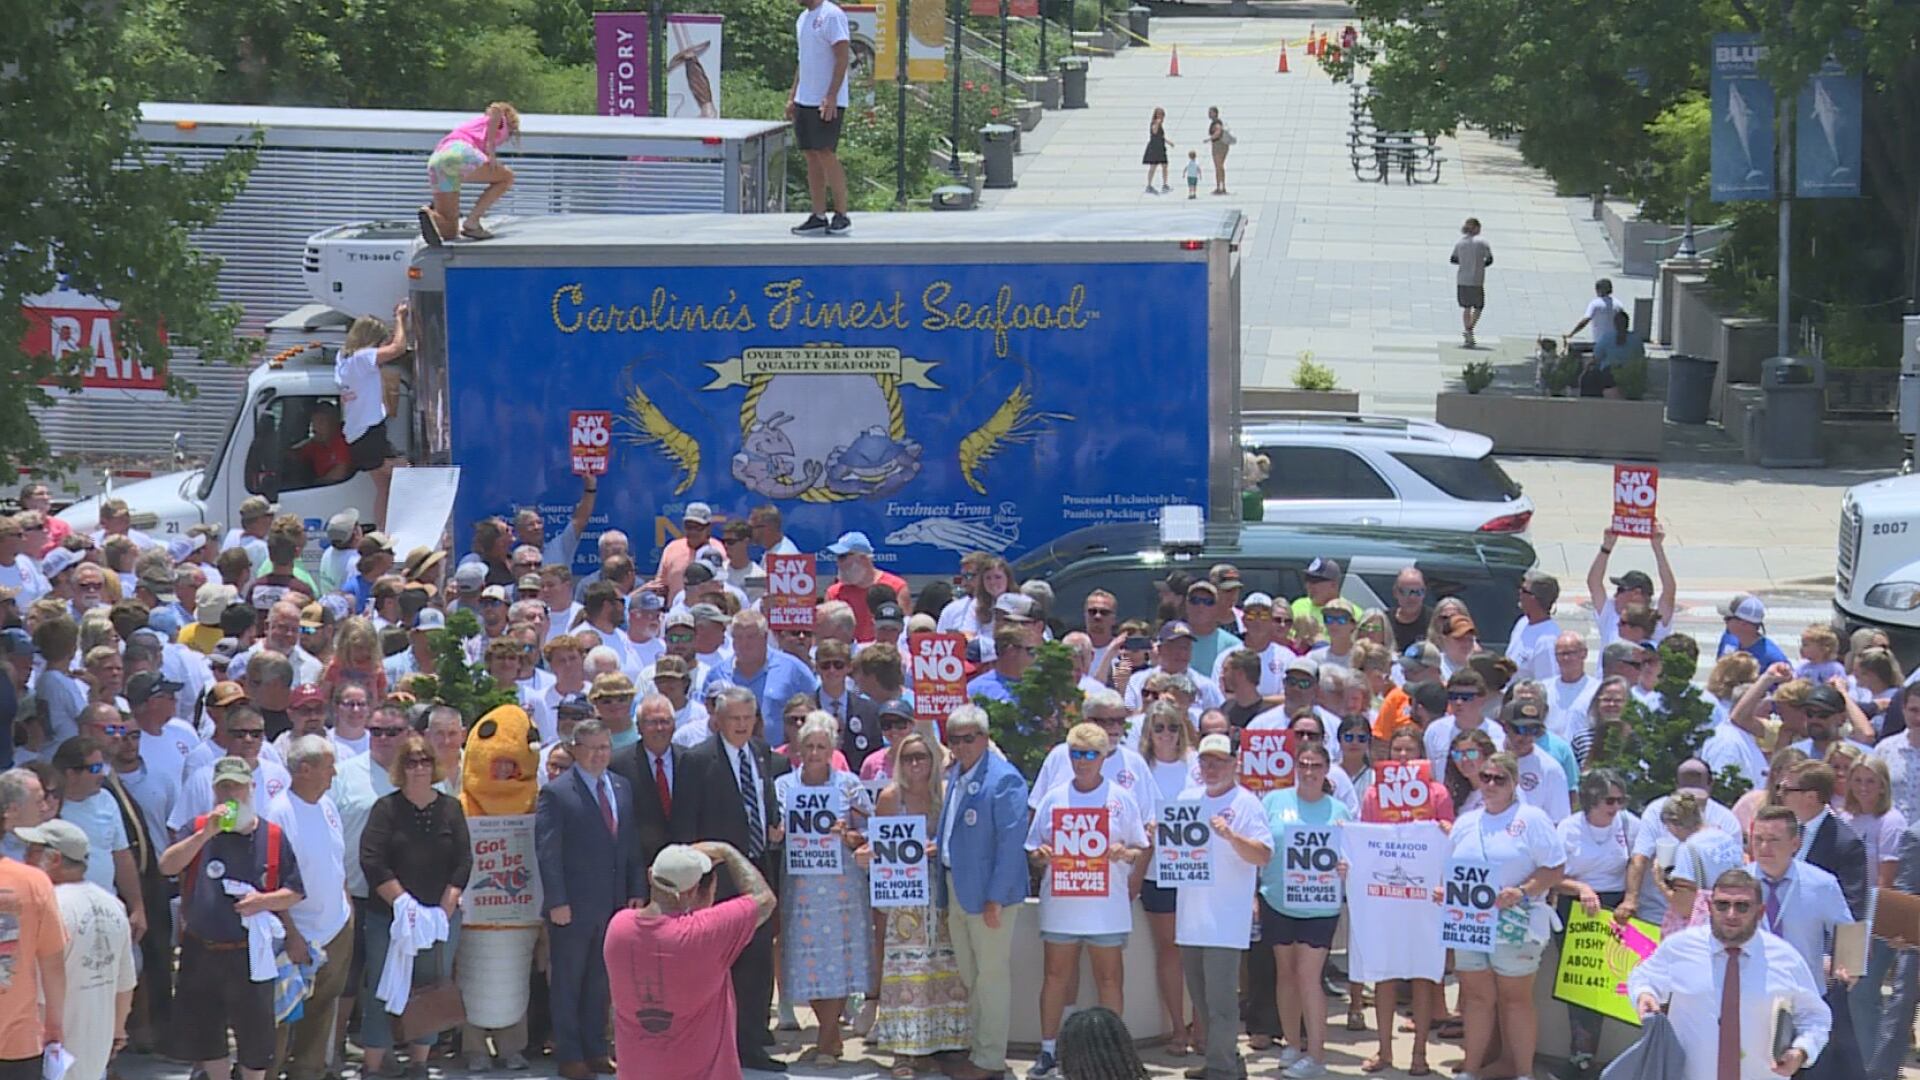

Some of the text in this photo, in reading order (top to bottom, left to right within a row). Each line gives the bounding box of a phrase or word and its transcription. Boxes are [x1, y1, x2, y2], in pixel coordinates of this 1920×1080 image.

[552, 283, 755, 333] Carolina's
[763, 278, 909, 330] Finest
[921, 281, 1088, 357] Seafood
[747, 350, 895, 359] OVER 70 YEARS OF NC
[757, 361, 890, 371] QUALITY SEAFOOD
[577, 416, 604, 428] SAY
[572, 427, 609, 447] NO
[1620, 471, 1651, 485] SAY
[1063, 494, 1112, 505] Processed
[1114, 494, 1168, 506] Exclusively
[1615, 483, 1656, 507] NO
[538, 502, 574, 513] Source
[886, 501, 950, 516] Freshness
[954, 501, 991, 516] From
[1106, 508, 1145, 520] Packing
[547, 515, 565, 525] NC
[166, 522, 180, 534] 21
[1872, 522, 1909, 535] 2007
[775, 560, 807, 573] SAY
[769, 573, 814, 595] NO
[921, 640, 956, 656] SAY
[914, 655, 963, 682] NO
[917, 695, 963, 704] NC HOUSE
[917, 703, 941, 714] BILL
[1250, 736, 1287, 751] SAY
[1243, 750, 1294, 777] NO
[1384, 766, 1420, 782] SAY
[1378, 780, 1428, 808] NO
[796, 794, 830, 809] SAY
[1164, 807, 1200, 821] SAY
[789, 810, 838, 834] NO
[1062, 814, 1100, 831] SAY
[879, 824, 915, 839] SAY
[1158, 822, 1210, 847] NO
[475, 838, 506, 855] Got
[1054, 830, 1107, 857] NO
[1294, 832, 1331, 847] SAY
[1368, 840, 1428, 851] NC SEAFOOD
[790, 850, 837, 858] NC HOUSE
[873, 839, 924, 864] NO
[1379, 850, 1397, 858] FOR
[478, 852, 522, 871] to be
[790, 859, 838, 868] BILL 442
[1176, 862, 1209, 870] HOUSE
[1287, 847, 1338, 872] NO
[1160, 871, 1210, 880] BILL 442
[1454, 866, 1490, 883] SAY
[890, 880, 923, 889] HOUSE
[1081, 880, 1105, 891] 442
[474, 894, 532, 906] SHRIMP
[875, 889, 924, 900] BILL 442
[1287, 893, 1337, 903] BILL 442
[1446, 881, 1496, 910] NO
[1444, 922, 1491, 935] NC HOUSE
[1442, 931, 1490, 945] BILL 442
[1575, 938, 1605, 950] FISHY
[1566, 955, 1603, 970] ABOUT
[1563, 971, 1583, 985] BILL
